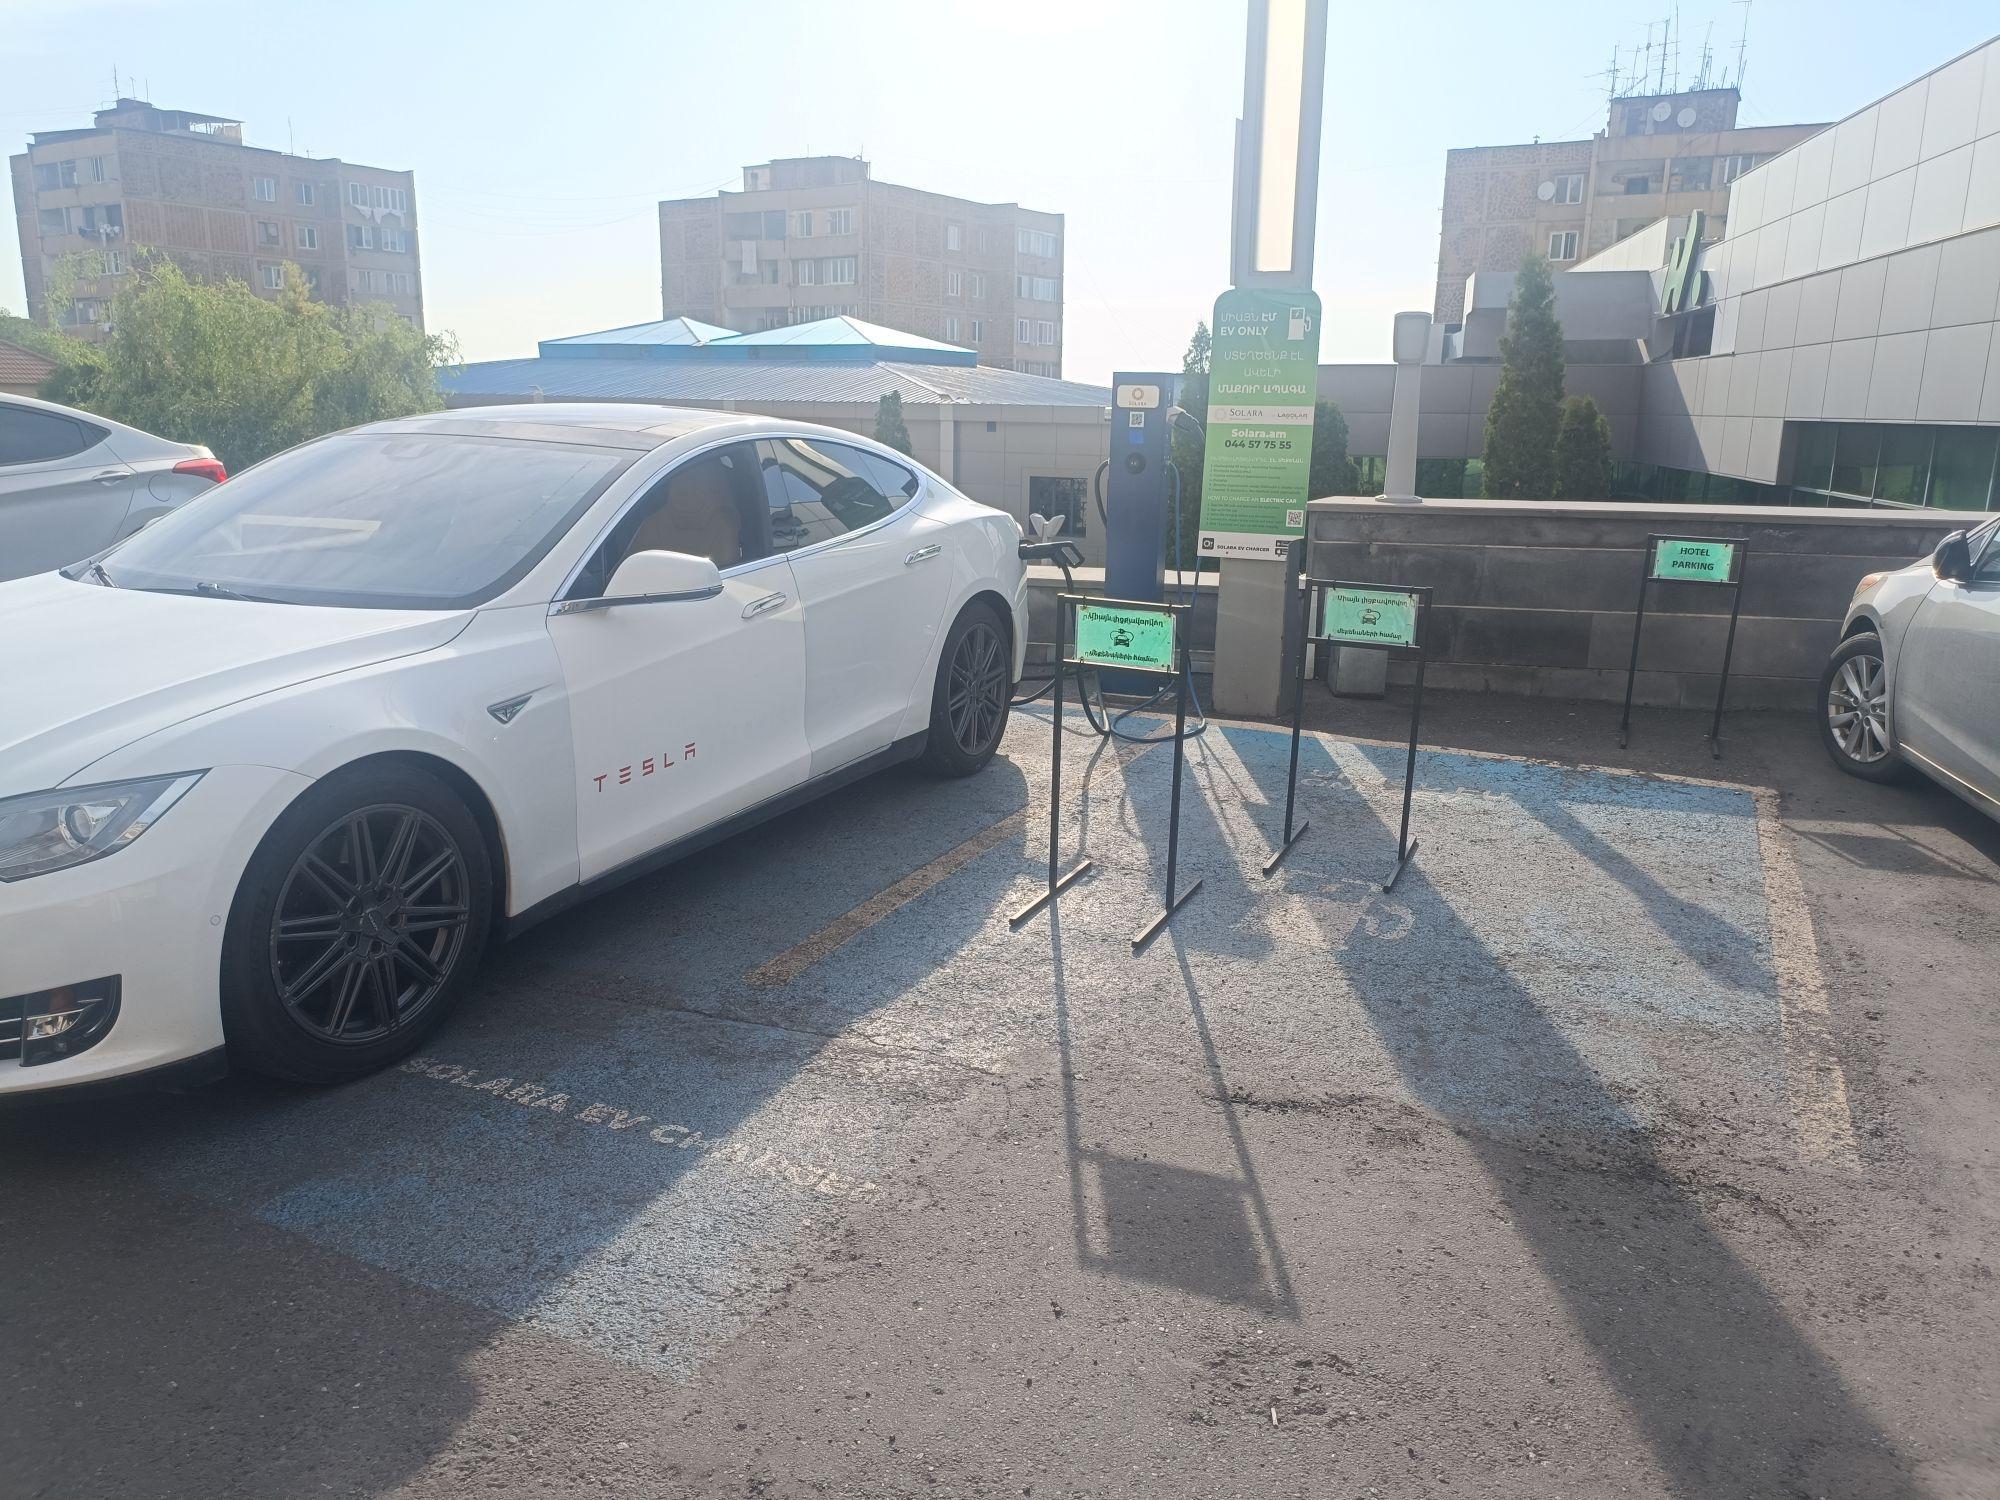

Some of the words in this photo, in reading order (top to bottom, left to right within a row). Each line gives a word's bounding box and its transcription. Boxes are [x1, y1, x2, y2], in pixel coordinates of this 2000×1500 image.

[1220, 326, 1235, 336] EV
[1237, 326, 1269, 336] ONLY
[1231, 428, 1287, 439] Solara.am
[1224, 439, 1246, 448] 044
[1247, 440, 1261, 449] 57
[1263, 440, 1277, 449] 75
[1278, 441, 1292, 450] 55
[1680, 547, 1711, 557] HOTEL
[1672, 560, 1714, 571] PARKING
[593, 742, 696, 793] TESLA
[574, 1102, 651, 1131] EV
